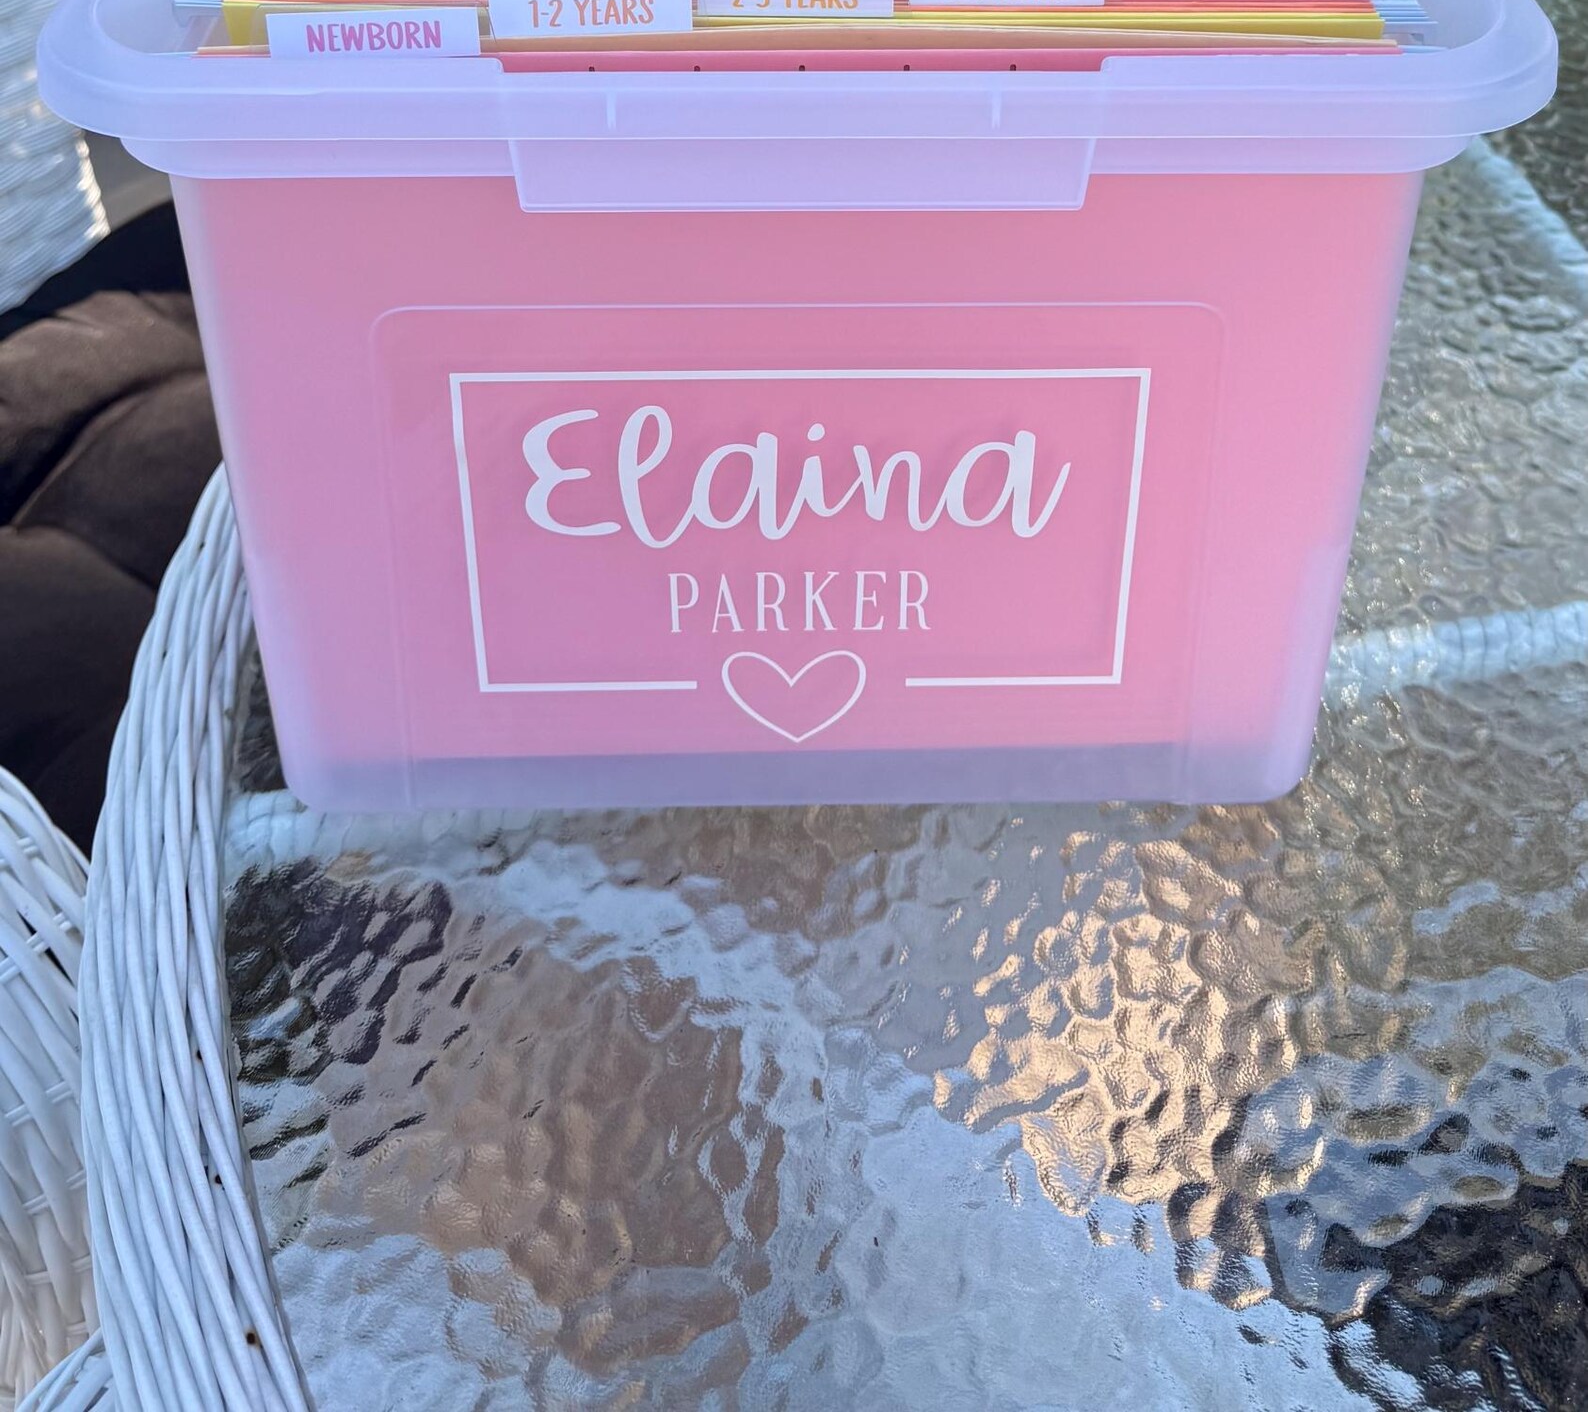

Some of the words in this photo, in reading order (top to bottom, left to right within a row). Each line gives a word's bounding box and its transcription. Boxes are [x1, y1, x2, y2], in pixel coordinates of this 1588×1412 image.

[306, 20, 442, 53] NEWBORN
[522, 404, 1072, 549] Elaina
[667, 570, 931, 634] PARKER
